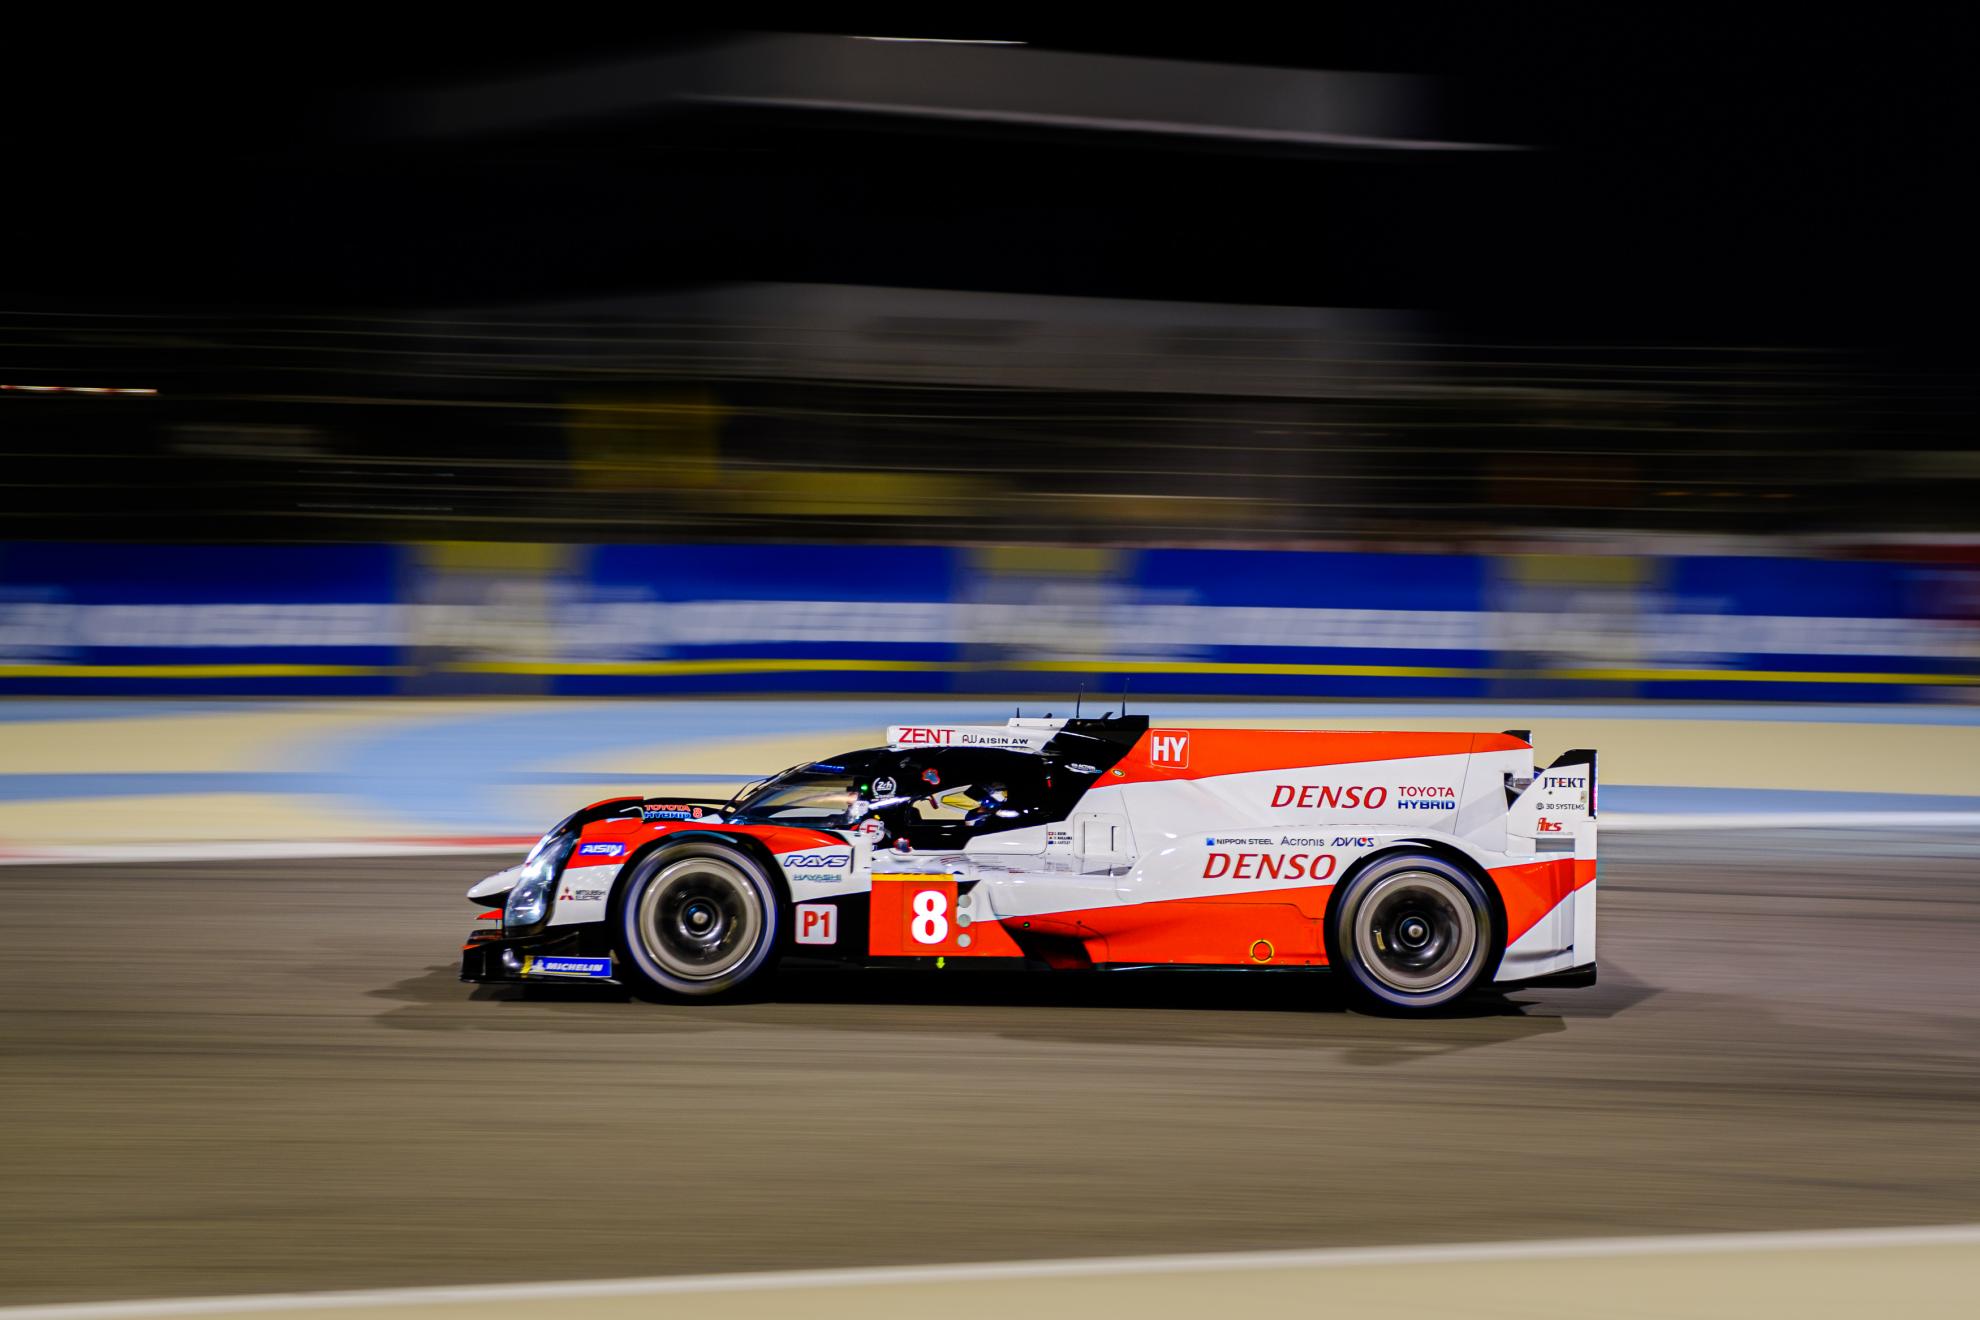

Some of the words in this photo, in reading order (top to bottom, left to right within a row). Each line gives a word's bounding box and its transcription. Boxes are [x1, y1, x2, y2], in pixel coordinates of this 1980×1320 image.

[898, 727, 955, 744] ZENT
[979, 736, 1009, 744] AISIN
[1153, 736, 1187, 762] HY
[1543, 777, 1586, 790] JTEKT
[1270, 785, 1388, 809] DENSO
[1397, 786, 1455, 798] TOYOTA
[1397, 800, 1456, 810] HYBRID
[1556, 803, 1585, 811] SYSTEMS
[692, 807, 703, 818] 8
[1280, 836, 1325, 847] Acronis
[1331, 837, 1375, 847] ADVICS
[581, 845, 623, 855] AISIN
[784, 855, 849, 867] RAYS
[1203, 853, 1337, 881] DENSO
[911, 890, 949, 945] 8
[803, 911, 830, 938] P1
[546, 963, 604, 972] MICHELIN
